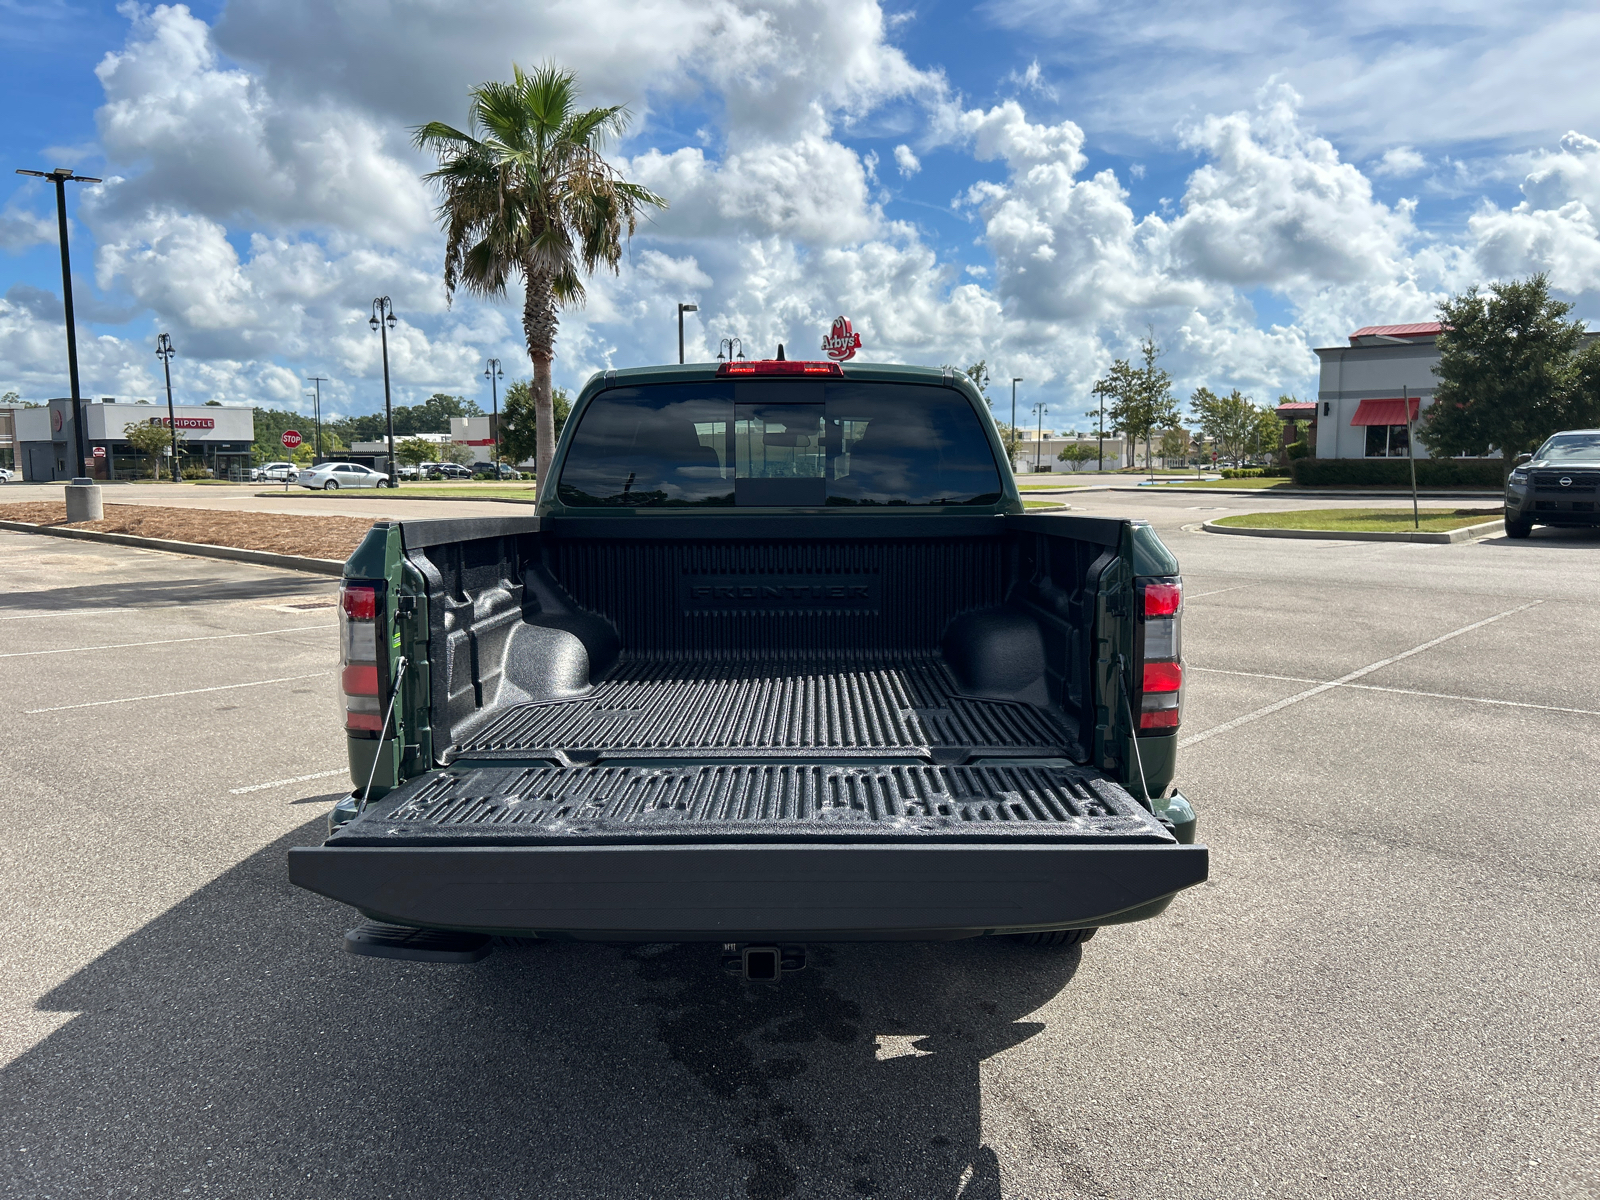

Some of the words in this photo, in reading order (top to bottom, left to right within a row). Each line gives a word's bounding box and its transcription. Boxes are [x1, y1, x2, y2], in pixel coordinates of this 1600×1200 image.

[821, 333, 855, 351] Arby's
[283, 435, 301, 443] STOP
[691, 585, 869, 599] FRONTIER
